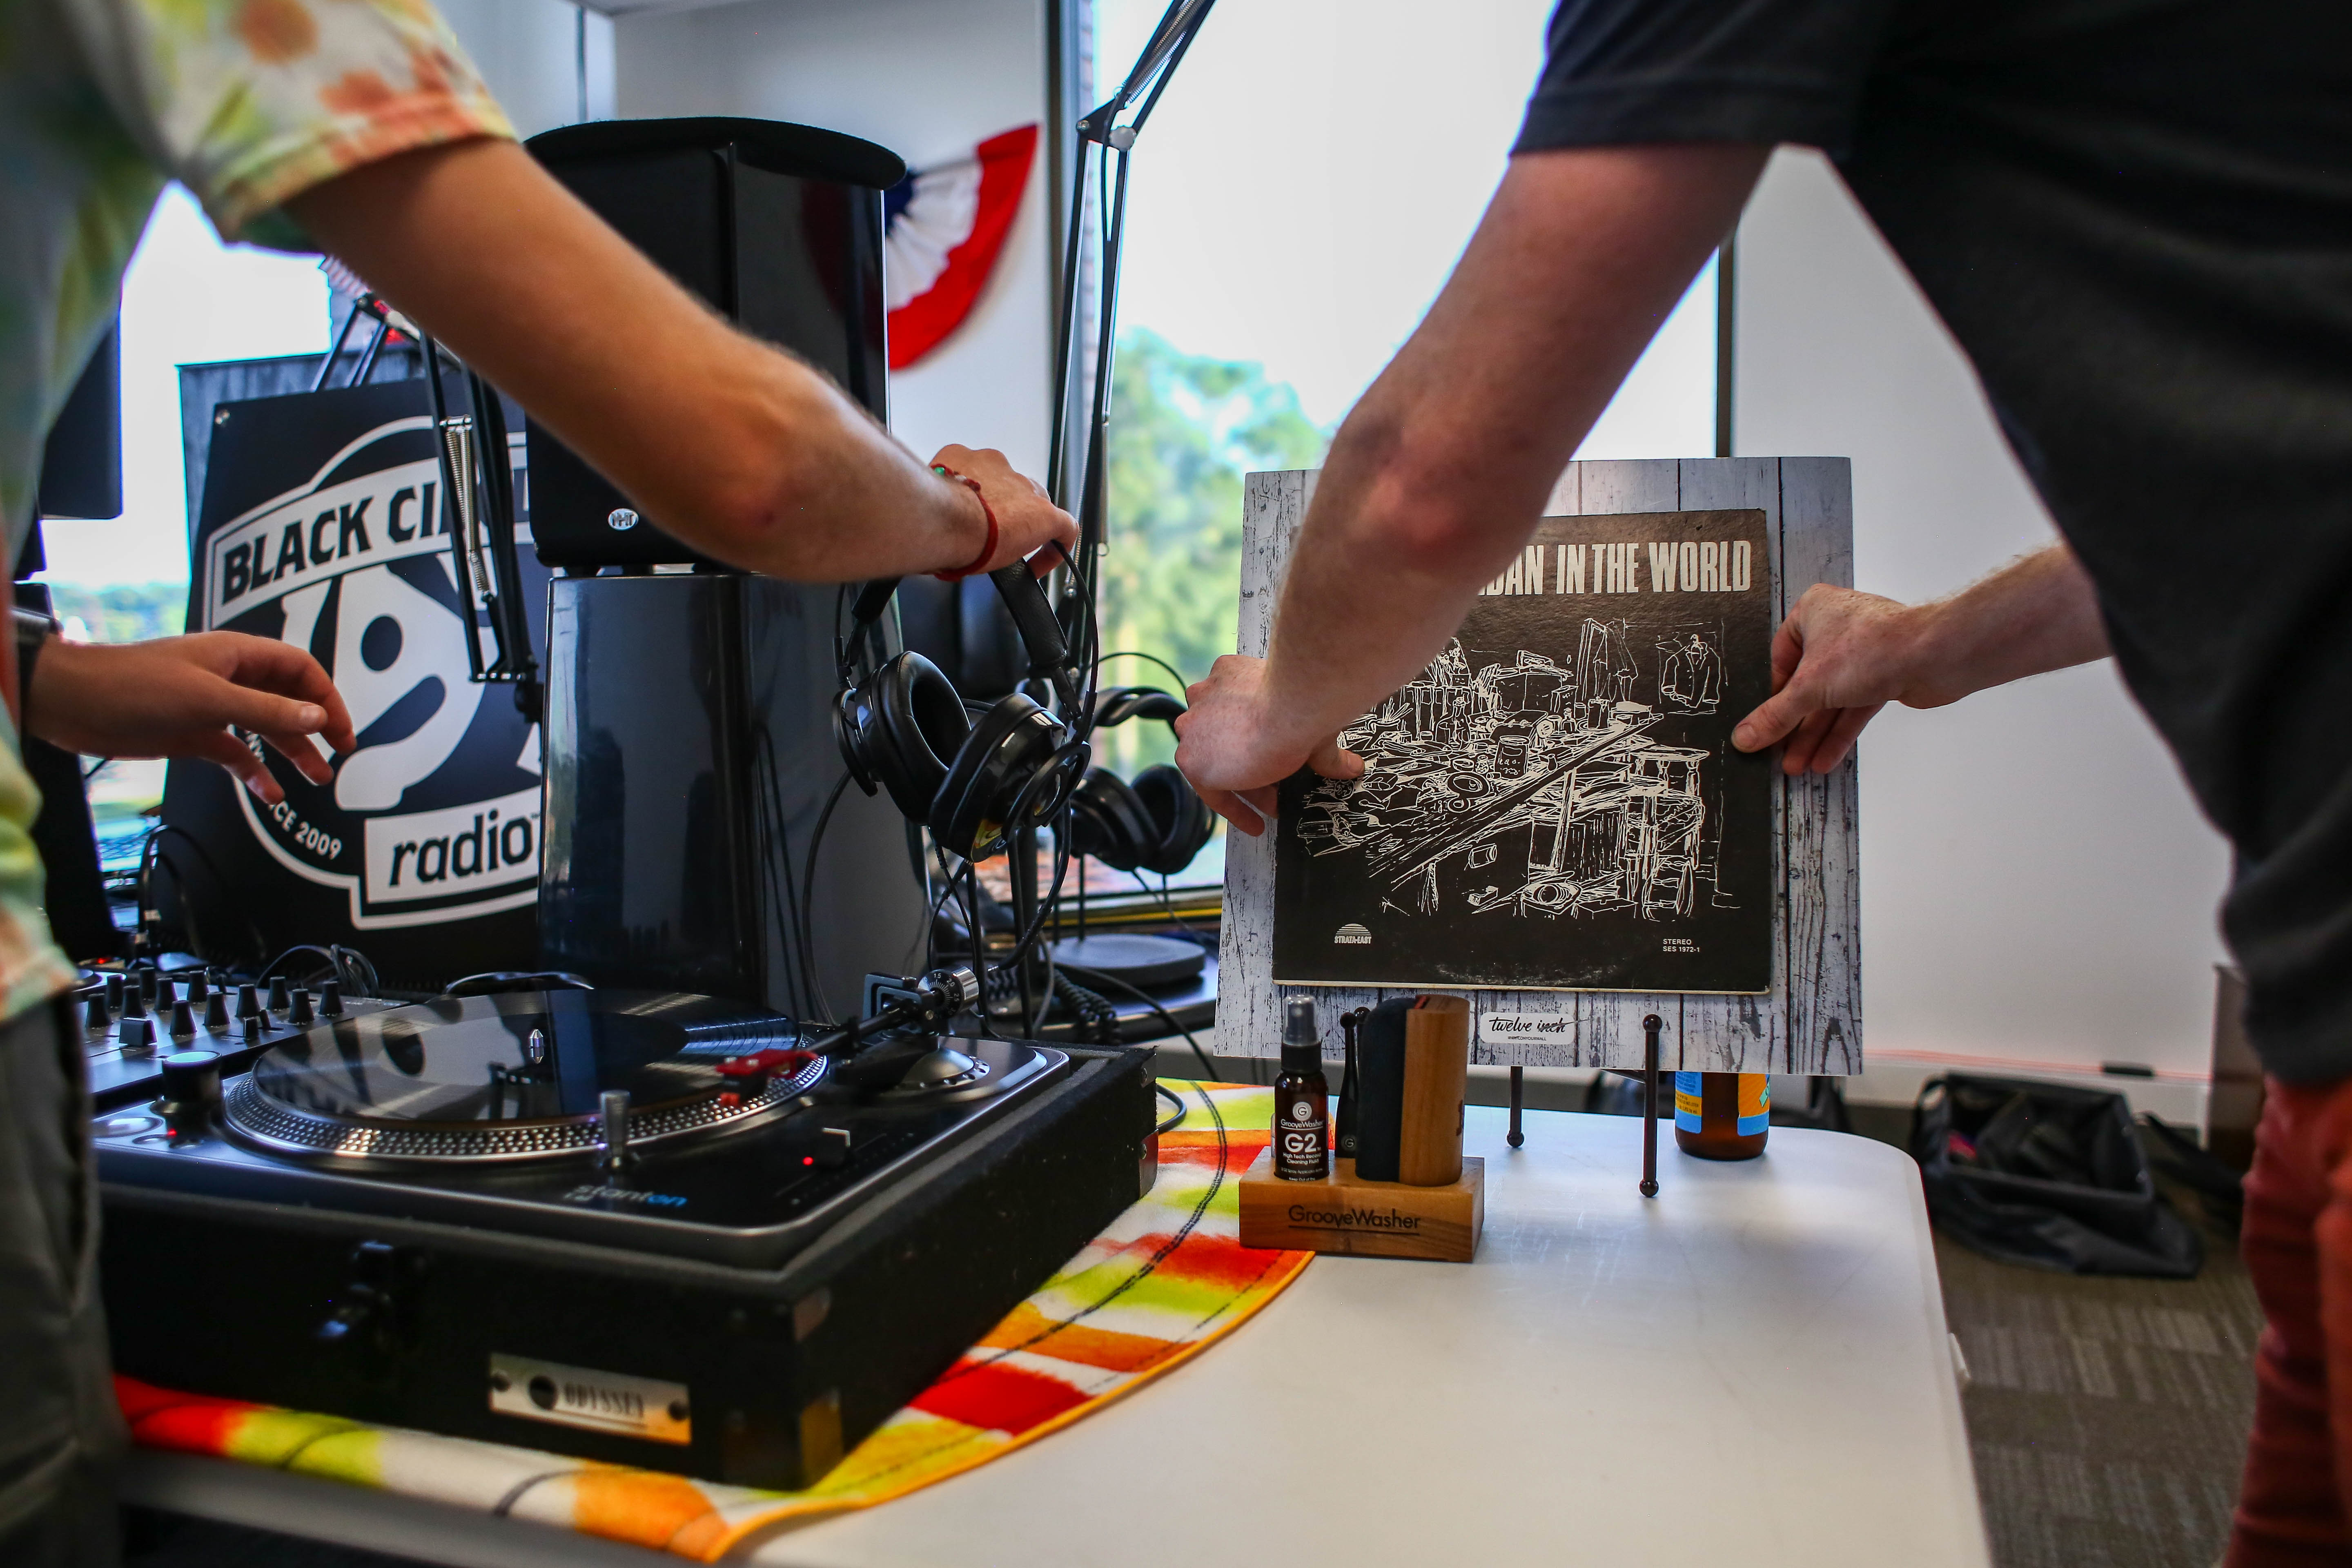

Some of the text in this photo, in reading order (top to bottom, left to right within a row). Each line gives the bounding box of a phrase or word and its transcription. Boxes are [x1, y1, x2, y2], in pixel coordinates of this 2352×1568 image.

[223, 496, 374, 605] BLACK
[1556, 544, 1586, 594] IN
[1592, 543, 1639, 593] THE
[1648, 540, 1751, 593] WORLD
[294, 821, 343, 860] 2009
[389, 808, 532, 887] radio
[1334, 935, 1372, 944] STRATA-EAST
[1489, 1016, 1566, 1033] twelve inch
[1281, 1118, 1324, 1129] GrooveWasher
[1285, 1133, 1317, 1153] G2
[1288, 1205, 1421, 1229] GrooveWasher
